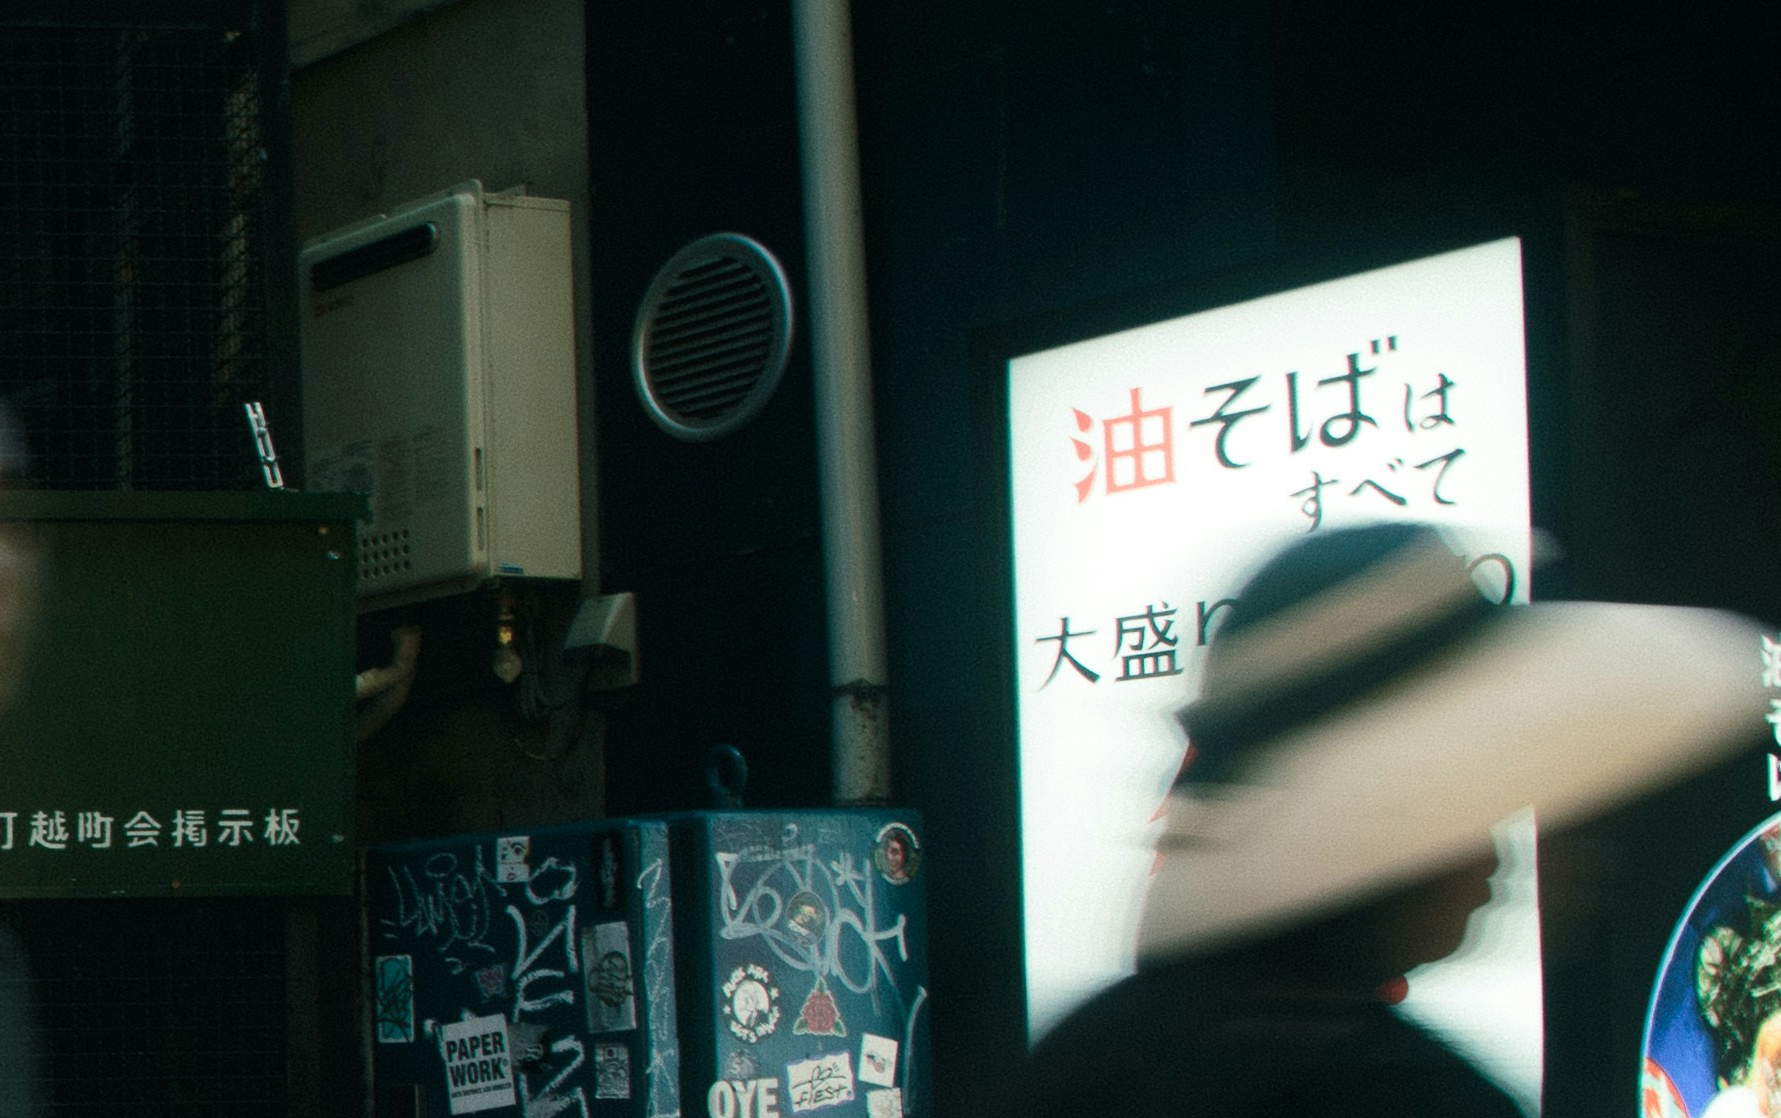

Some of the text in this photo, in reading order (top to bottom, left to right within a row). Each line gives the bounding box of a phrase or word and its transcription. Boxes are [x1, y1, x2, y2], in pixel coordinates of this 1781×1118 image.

[1290, 448, 1466, 533] すべて
[445, 1031, 506, 1063] PAPER
